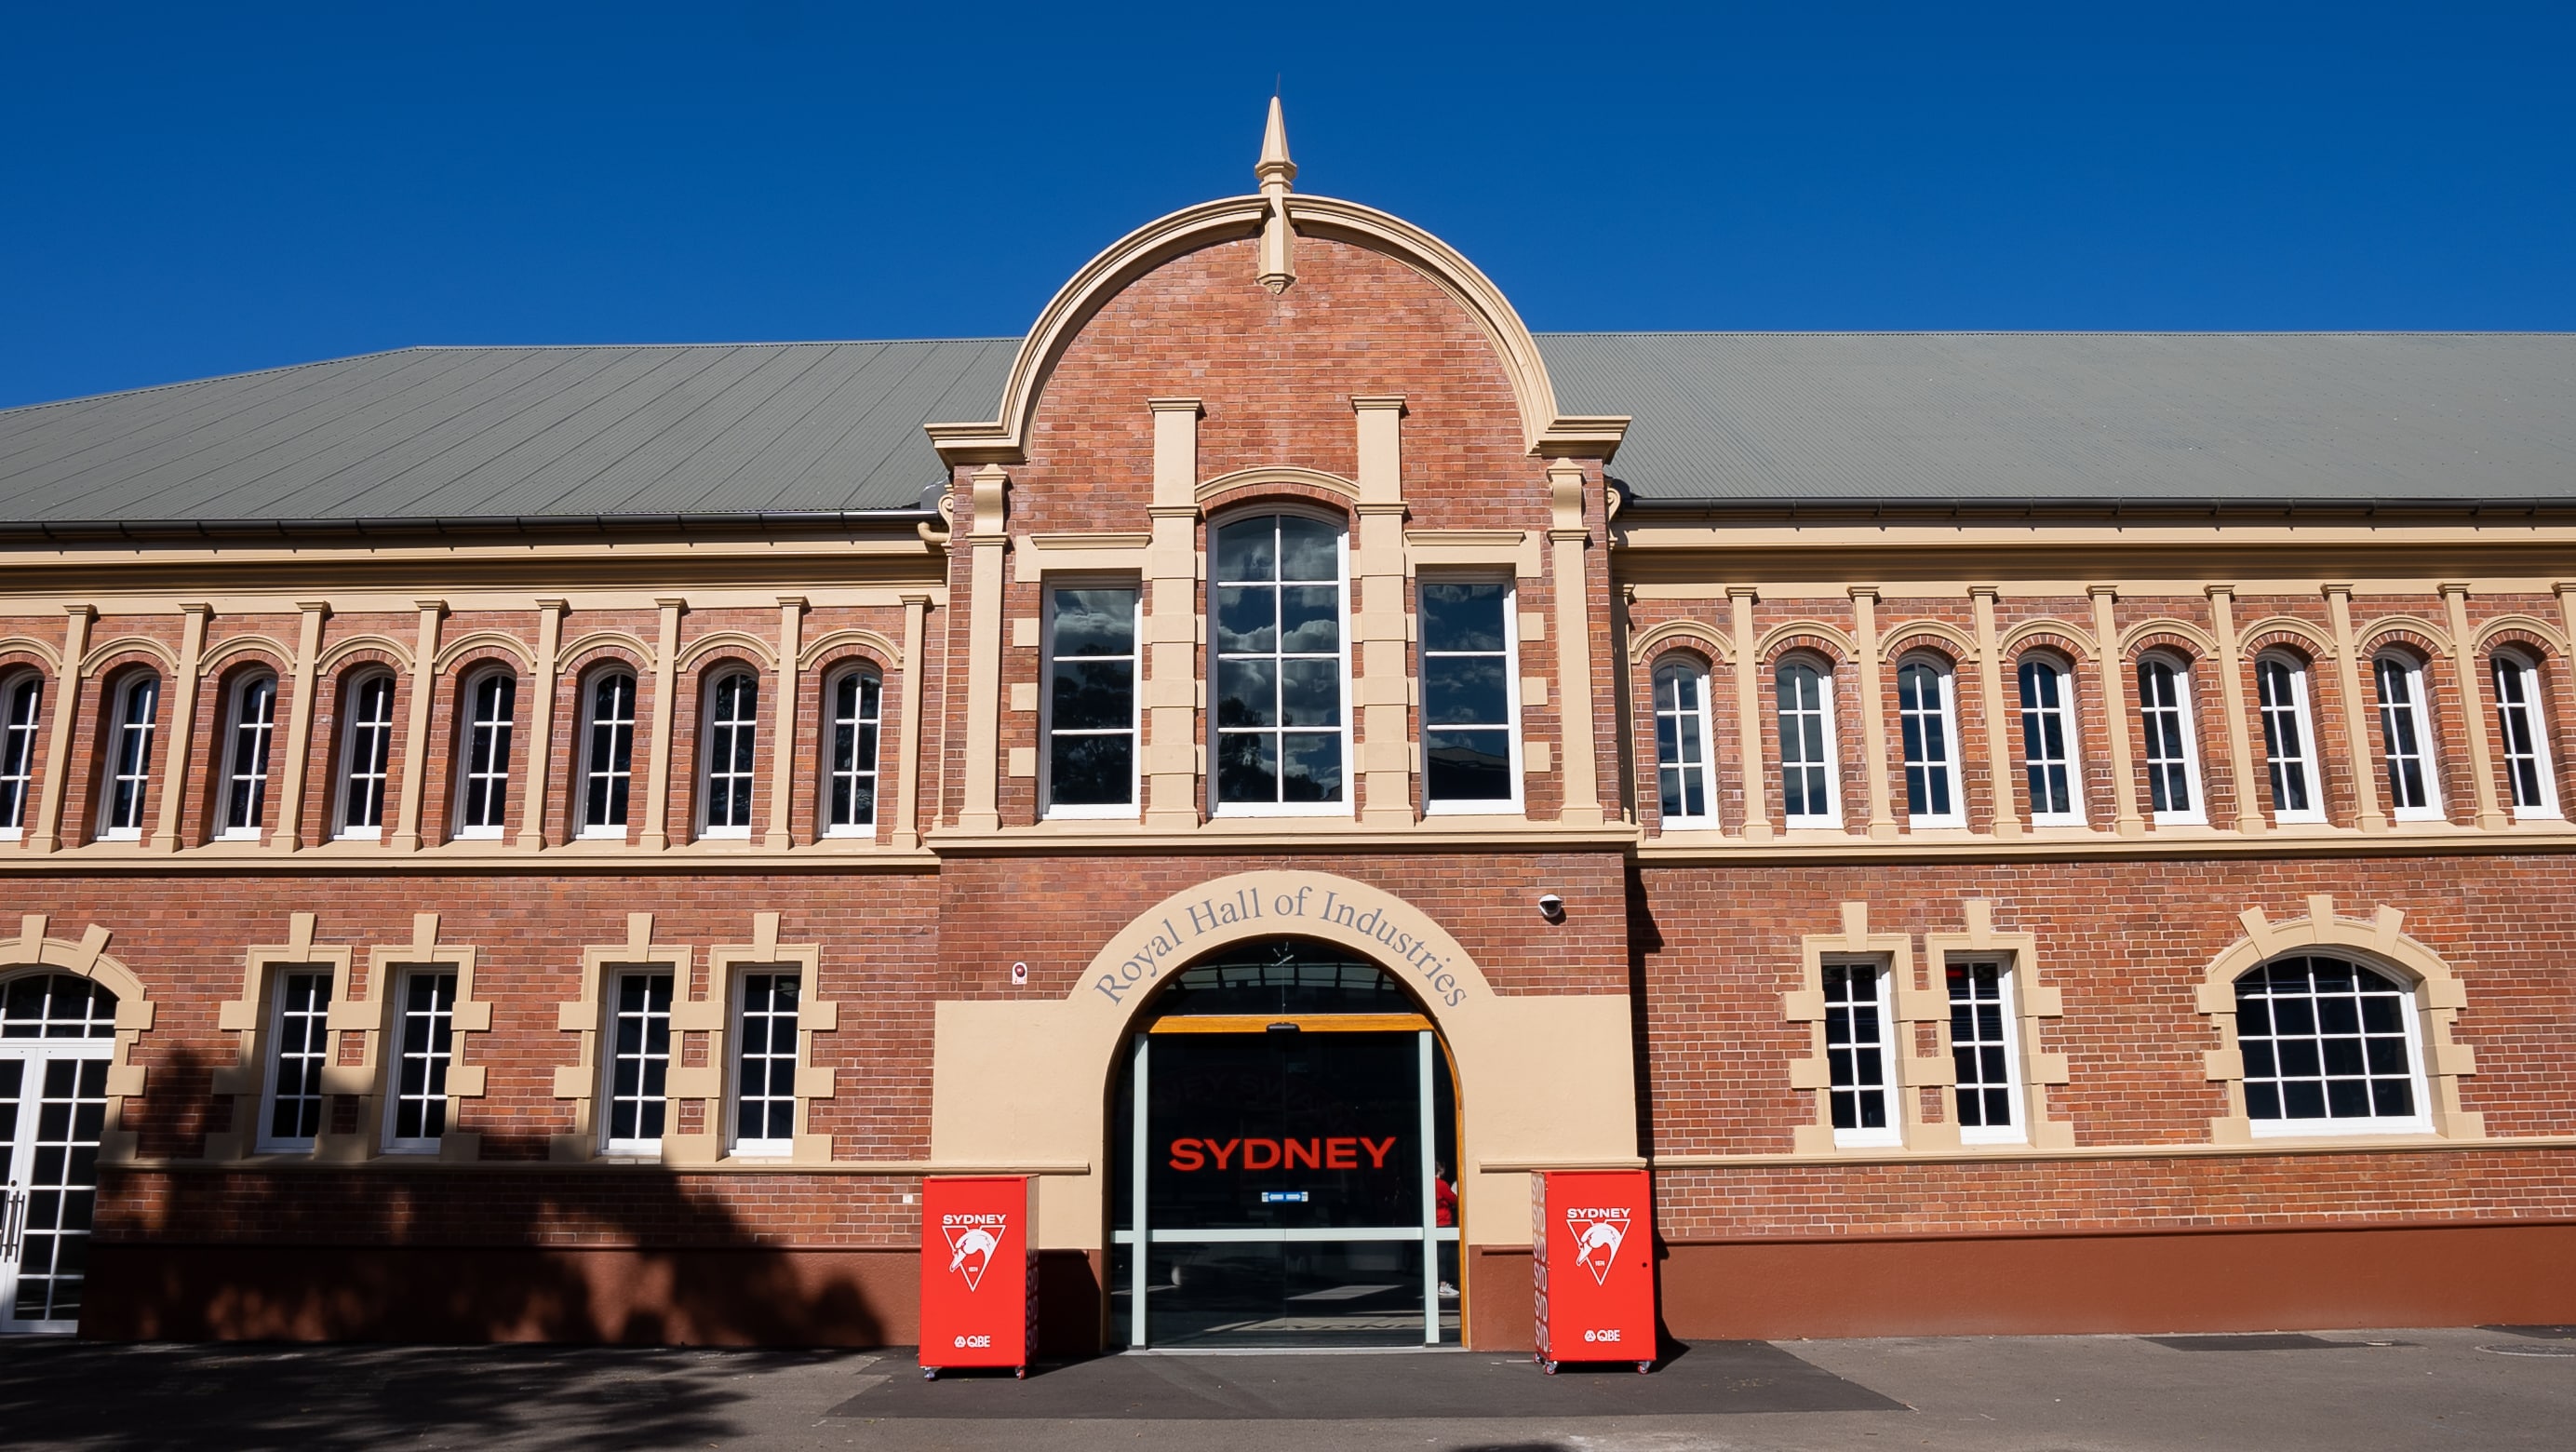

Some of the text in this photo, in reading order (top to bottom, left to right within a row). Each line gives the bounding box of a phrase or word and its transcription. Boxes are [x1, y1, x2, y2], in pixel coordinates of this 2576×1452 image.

[1093, 885, 1468, 1008] Royal Hall of Industries
[1168, 1136, 1397, 1171] SYDNEY
[1566, 1207, 1630, 1219] SYDNEY
[942, 1214, 1007, 1225] SYDNEY
[1597, 1329, 1621, 1342] QBE
[966, 1336, 990, 1348] QBE
